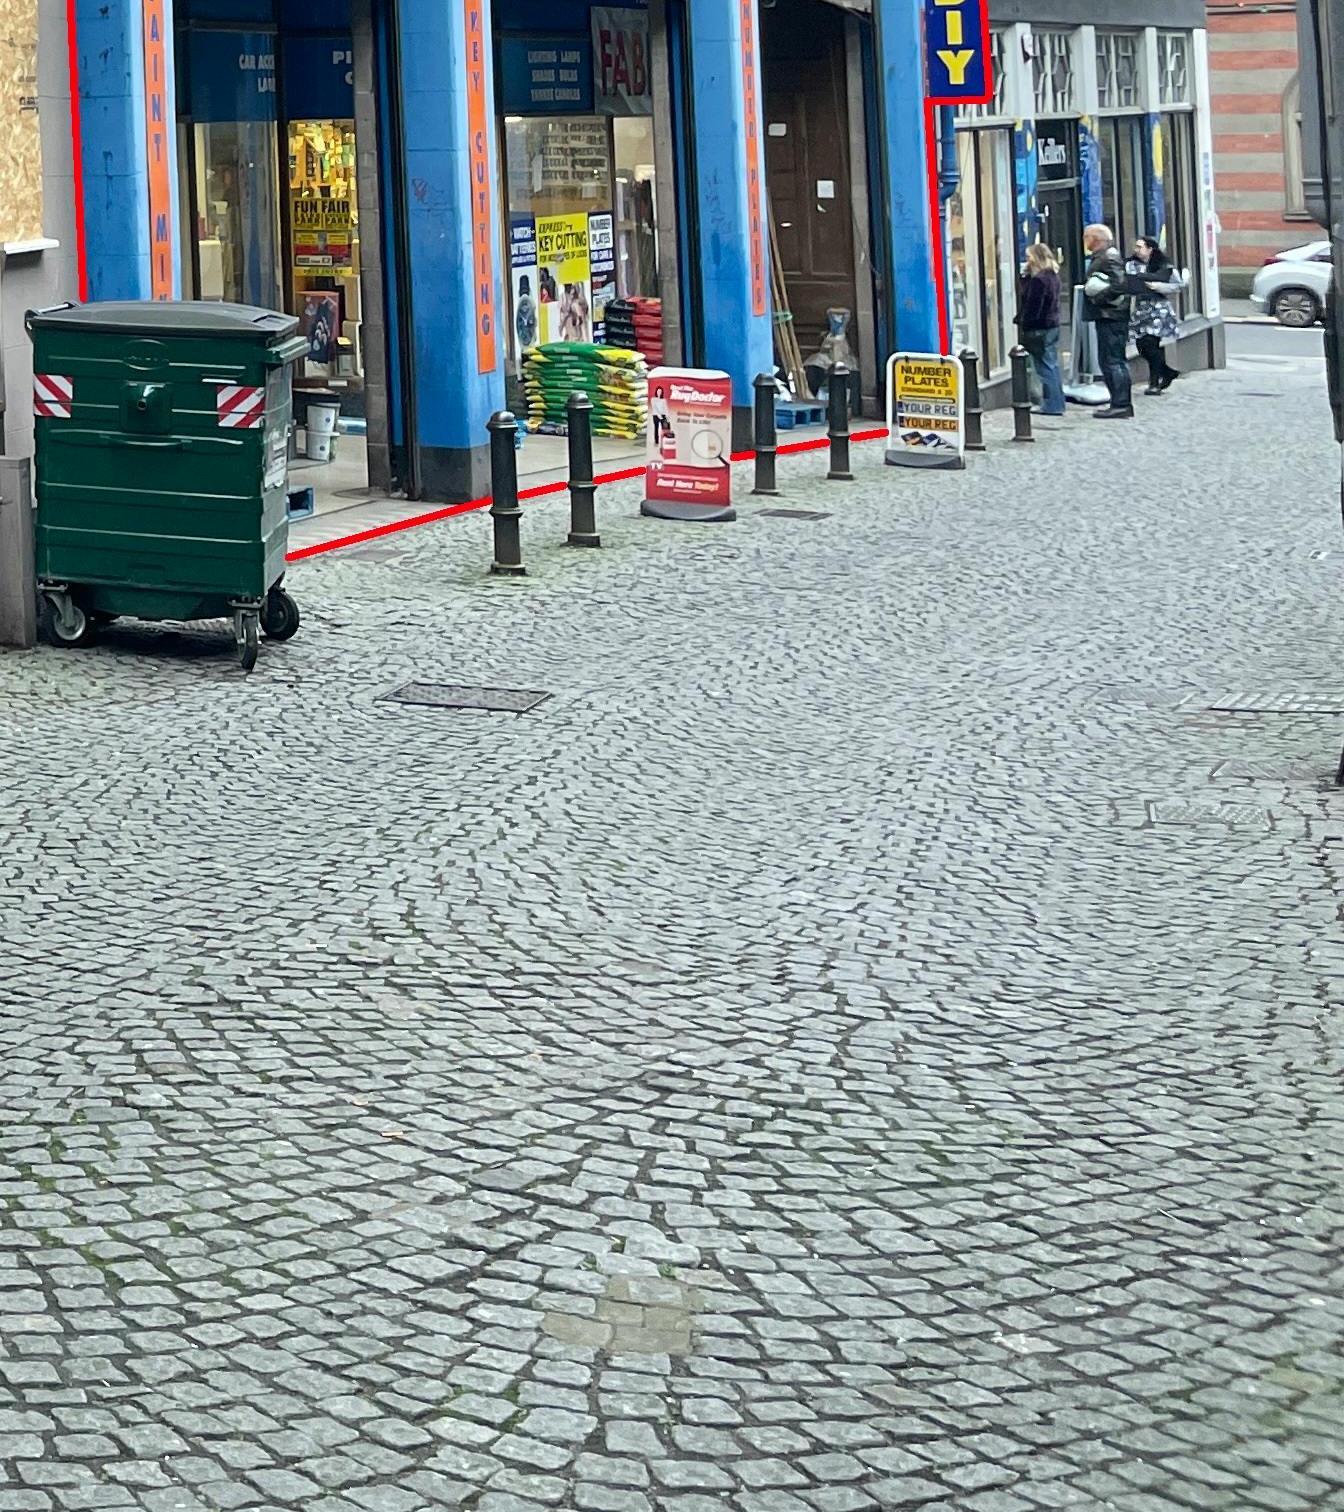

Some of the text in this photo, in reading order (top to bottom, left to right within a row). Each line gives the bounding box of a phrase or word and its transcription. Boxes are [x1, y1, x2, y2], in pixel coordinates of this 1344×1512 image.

[294, 201, 349, 213] FUN FAIR
[539, 235, 554, 252] KEY
[556, 232, 587, 251] CUTTING
[901, 365, 951, 377] NUMBER
[904, 376, 949, 387] PLATES
[905, 403, 956, 415] YOUR REG
[906, 418, 956, 430] YOUR REG
